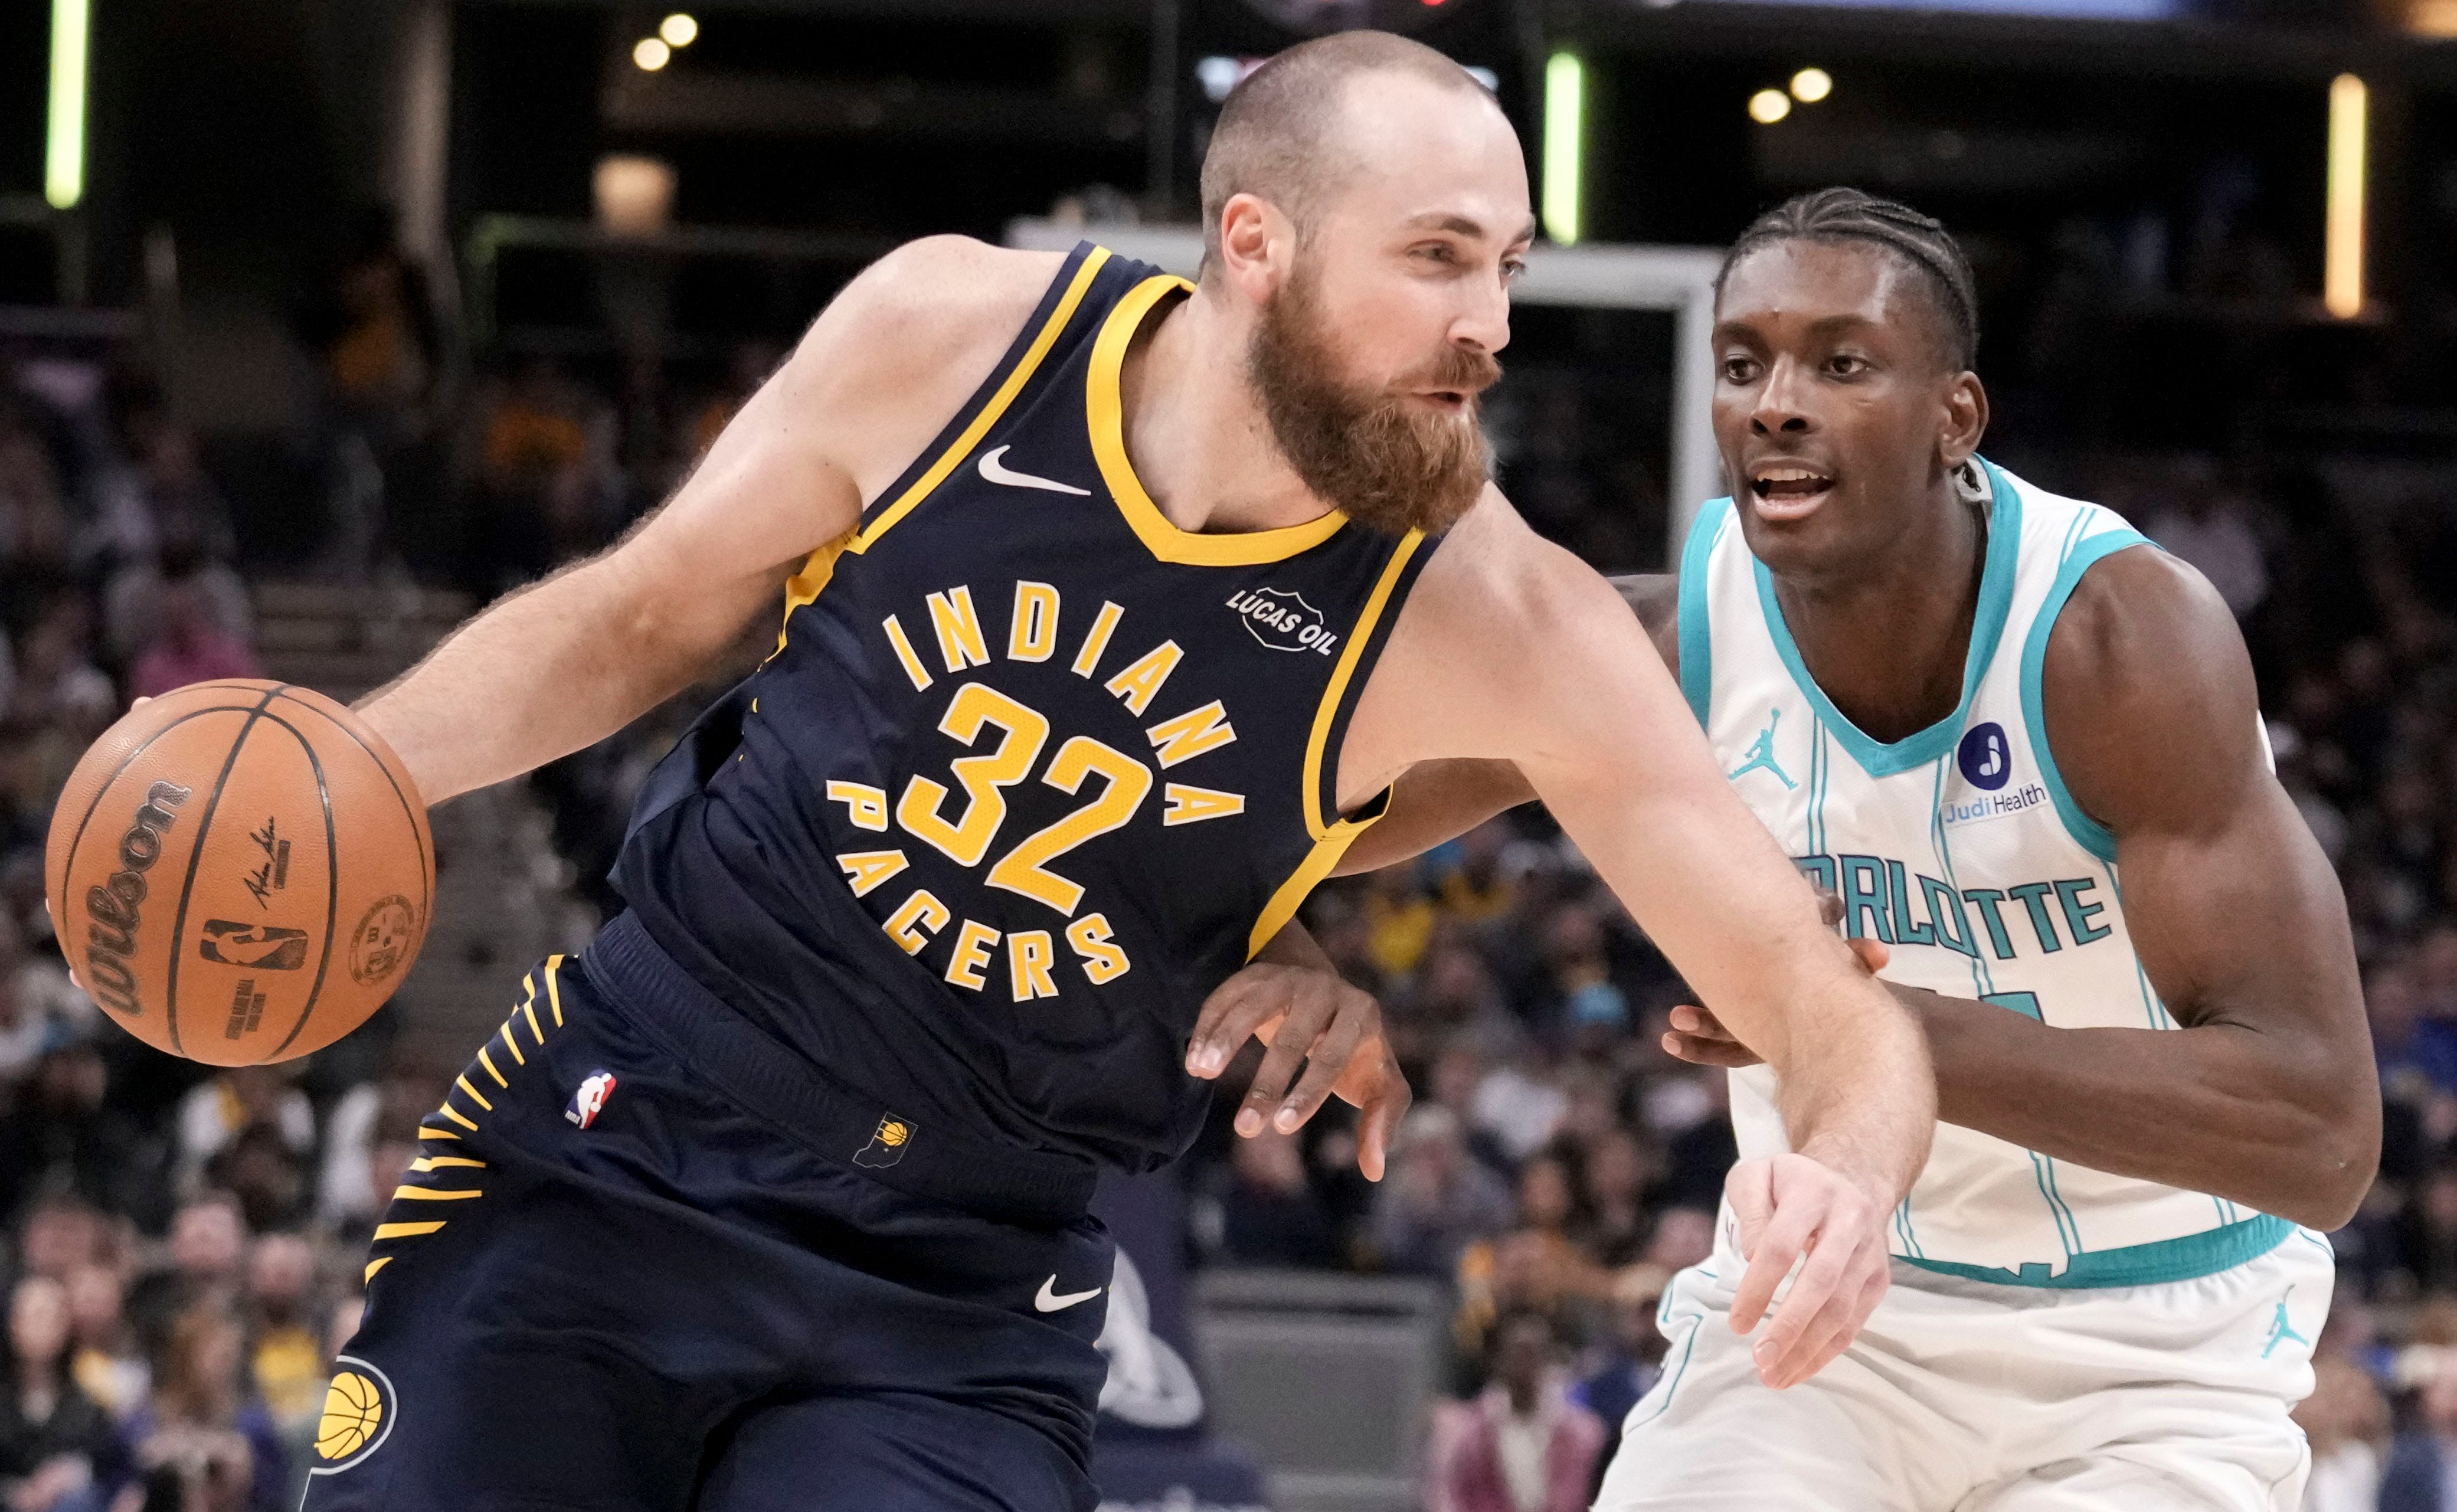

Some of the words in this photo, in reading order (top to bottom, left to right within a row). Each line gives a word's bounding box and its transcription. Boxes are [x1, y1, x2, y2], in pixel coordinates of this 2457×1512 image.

[882, 580, 1245, 826] INDIANA
[1225, 590, 1302, 633] LUCAS
[1298, 624, 1338, 656] OIL
[85, 780, 194, 1017] Wilson
[826, 779, 1131, 1003] PACERS
[896, 682, 1153, 917] 32
[1947, 798, 1991, 823] Judi
[1993, 784, 2046, 814] Health
